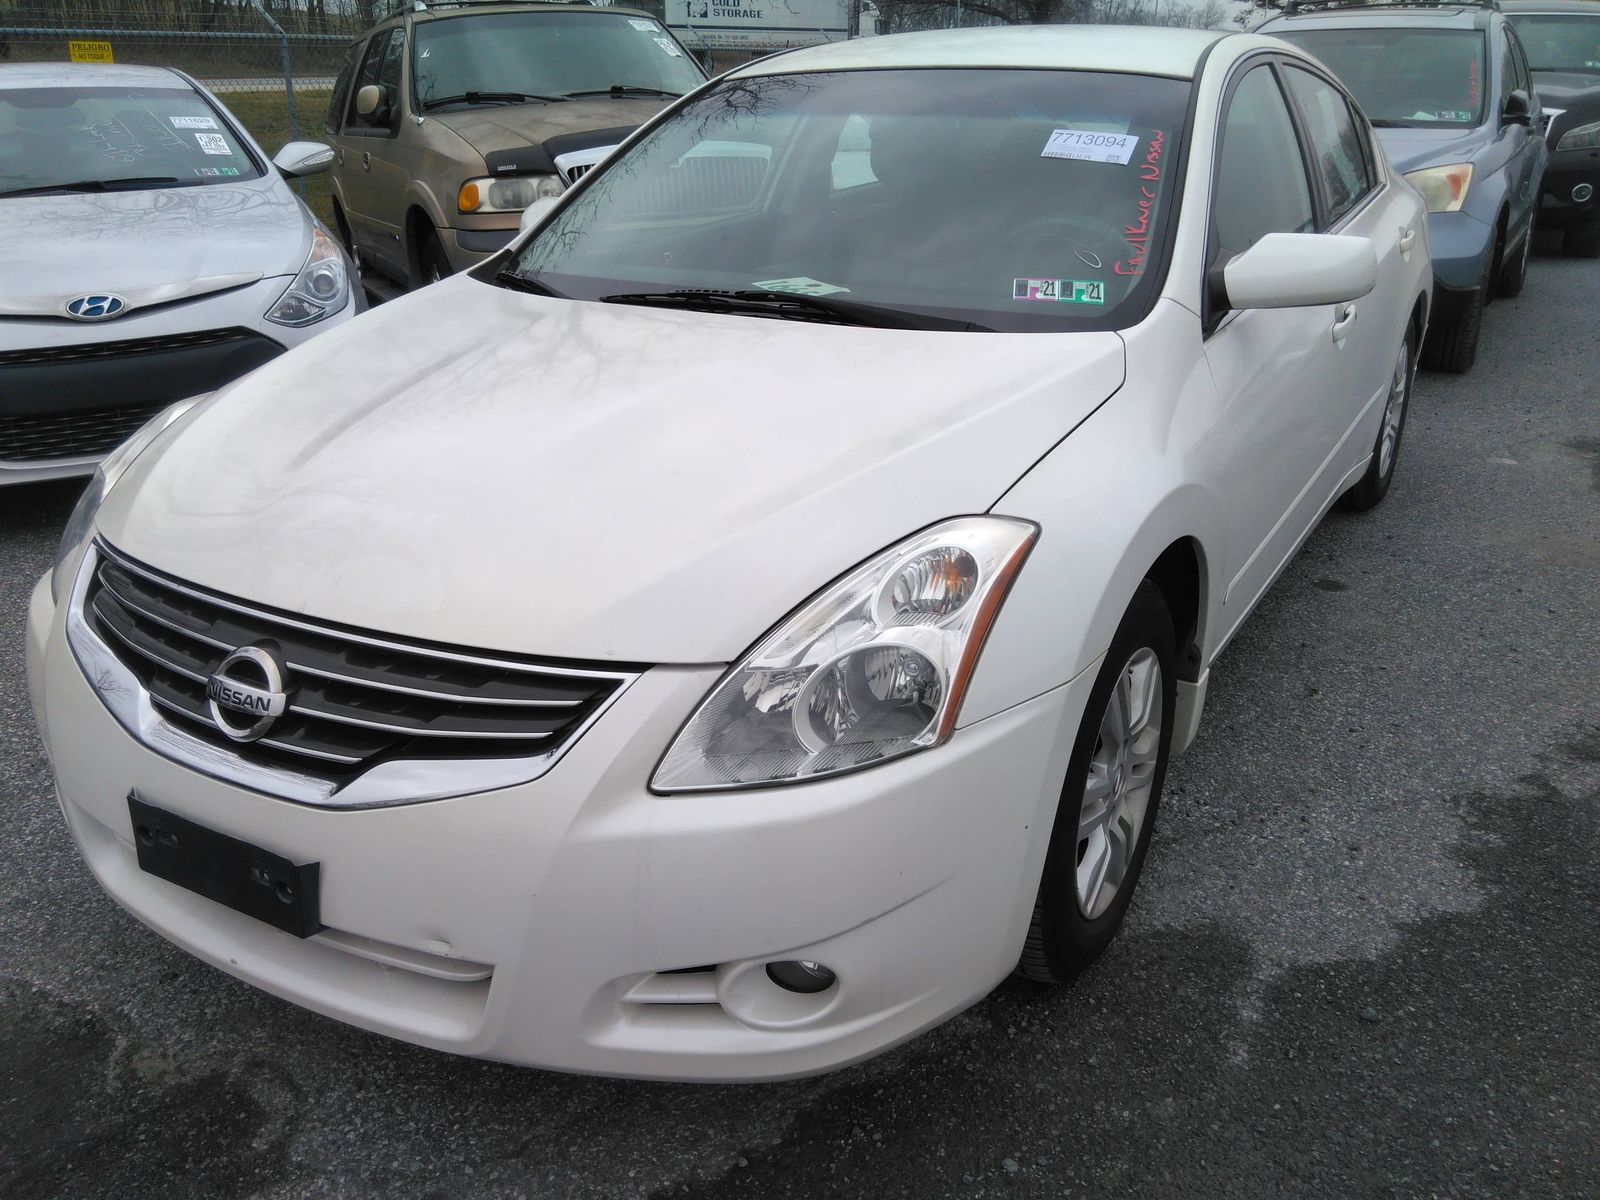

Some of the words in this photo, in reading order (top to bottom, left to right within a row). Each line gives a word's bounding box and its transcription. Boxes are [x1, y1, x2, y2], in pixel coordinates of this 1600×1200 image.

[712, 8, 764, 19] STORAGE
[71, 43, 110, 51] PELIGRO
[1052, 131, 1128, 149] 7713094
[1043, 280, 1056, 297] 21
[1089, 283, 1102, 300] 21
[207, 679, 272, 712] NISSAN
